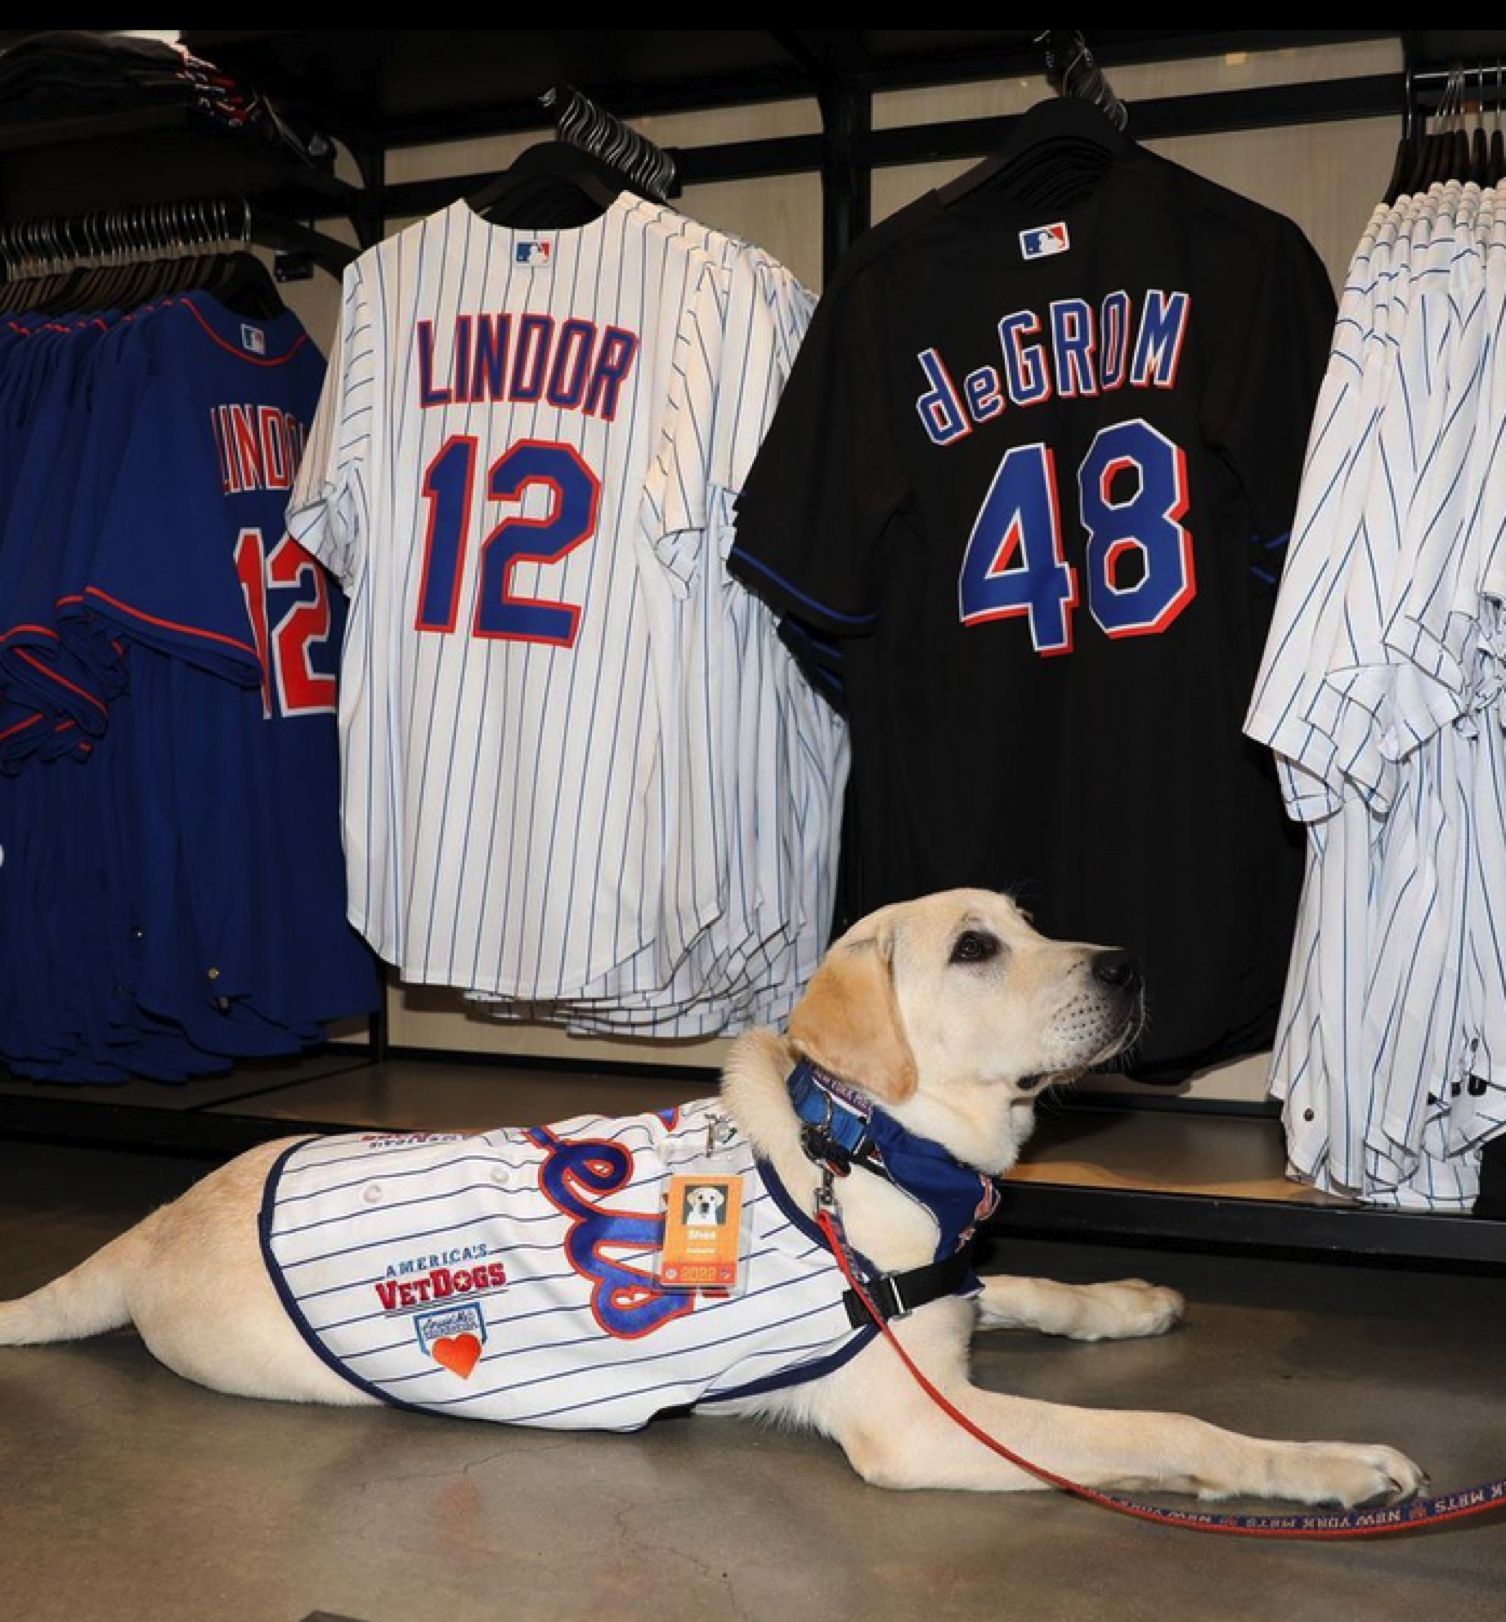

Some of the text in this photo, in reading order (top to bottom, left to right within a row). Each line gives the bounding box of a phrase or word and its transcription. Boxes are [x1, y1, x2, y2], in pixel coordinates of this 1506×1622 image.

[417, 313, 639, 422] LINDOR
[916, 289, 1190, 446] deGROM
[233, 527, 338, 720] 12
[414, 434, 602, 648] 12
[959, 417, 1197, 657] 48
[386, 1243, 488, 1278] AMERICA'S
